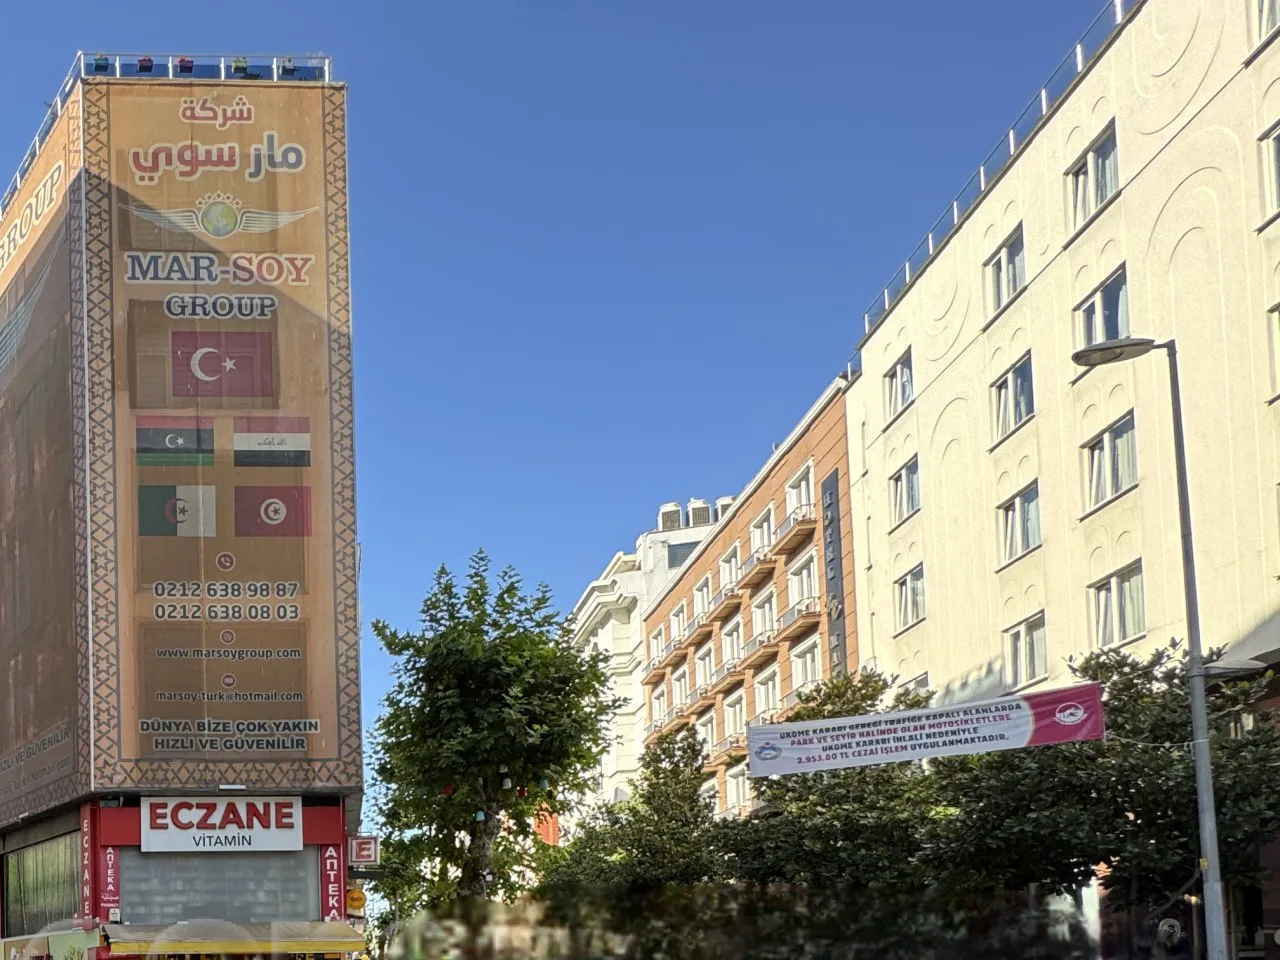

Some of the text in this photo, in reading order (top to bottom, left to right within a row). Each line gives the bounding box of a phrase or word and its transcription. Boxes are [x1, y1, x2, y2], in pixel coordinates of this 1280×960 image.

[180, 95, 253, 128] شركة
[132, 133, 303, 183] مار سوي
[127, 255, 312, 282] MAR-SOY
[165, 295, 276, 317] GROUP
[154, 582, 299, 597] 0212 638 98 87
[154, 604, 299, 619] 0212 638 08 03
[156, 648, 301, 660] www.marsoygroup.com
[140, 718, 319, 734] DÜNYA BİZE ÇOK YAKIN
[780, 729, 810, 739] UKOME
[790, 738, 814, 747] PARK
[816, 736, 828, 744] VE
[901, 724, 926, 733] OLAN
[154, 736, 306, 750] HIZLI VE GÜVENİLİR
[822, 741, 853, 752] UKOME
[856, 737, 890, 748] KARARI
[925, 727, 979, 740] NEDENİYLE
[840, 751, 849, 759] TL
[150, 801, 295, 830] ECZANE
[193, 833, 252, 847] VİTAMİN
[356, 841, 372, 860] E
[106, 846, 115, 891] АПТЕКА
